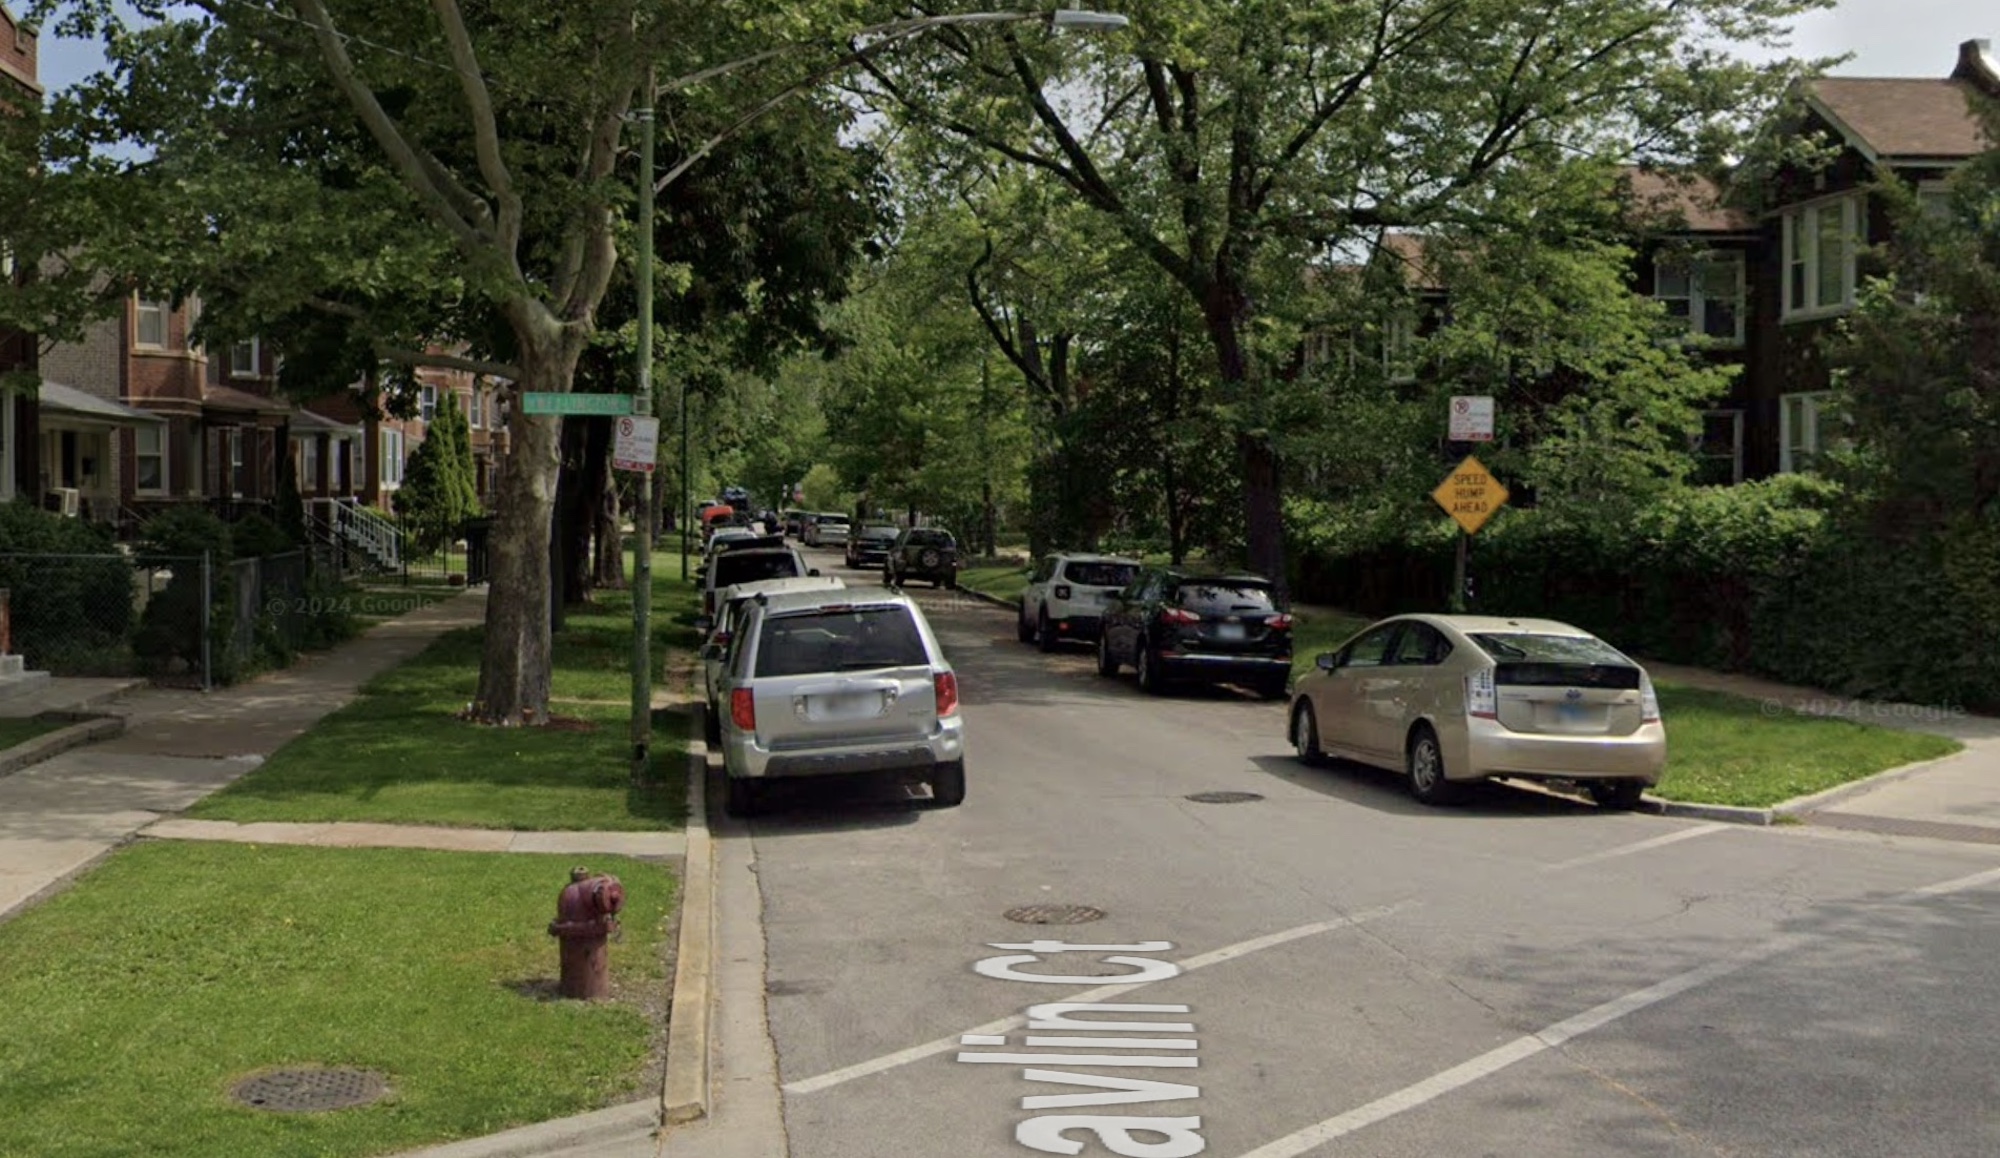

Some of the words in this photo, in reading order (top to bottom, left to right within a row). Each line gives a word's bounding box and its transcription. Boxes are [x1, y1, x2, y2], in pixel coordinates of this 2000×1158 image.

[1453, 473, 1488, 485] SPEED
[1454, 487, 1486, 498] HUMP
[1452, 501, 1488, 513] AHEAD
